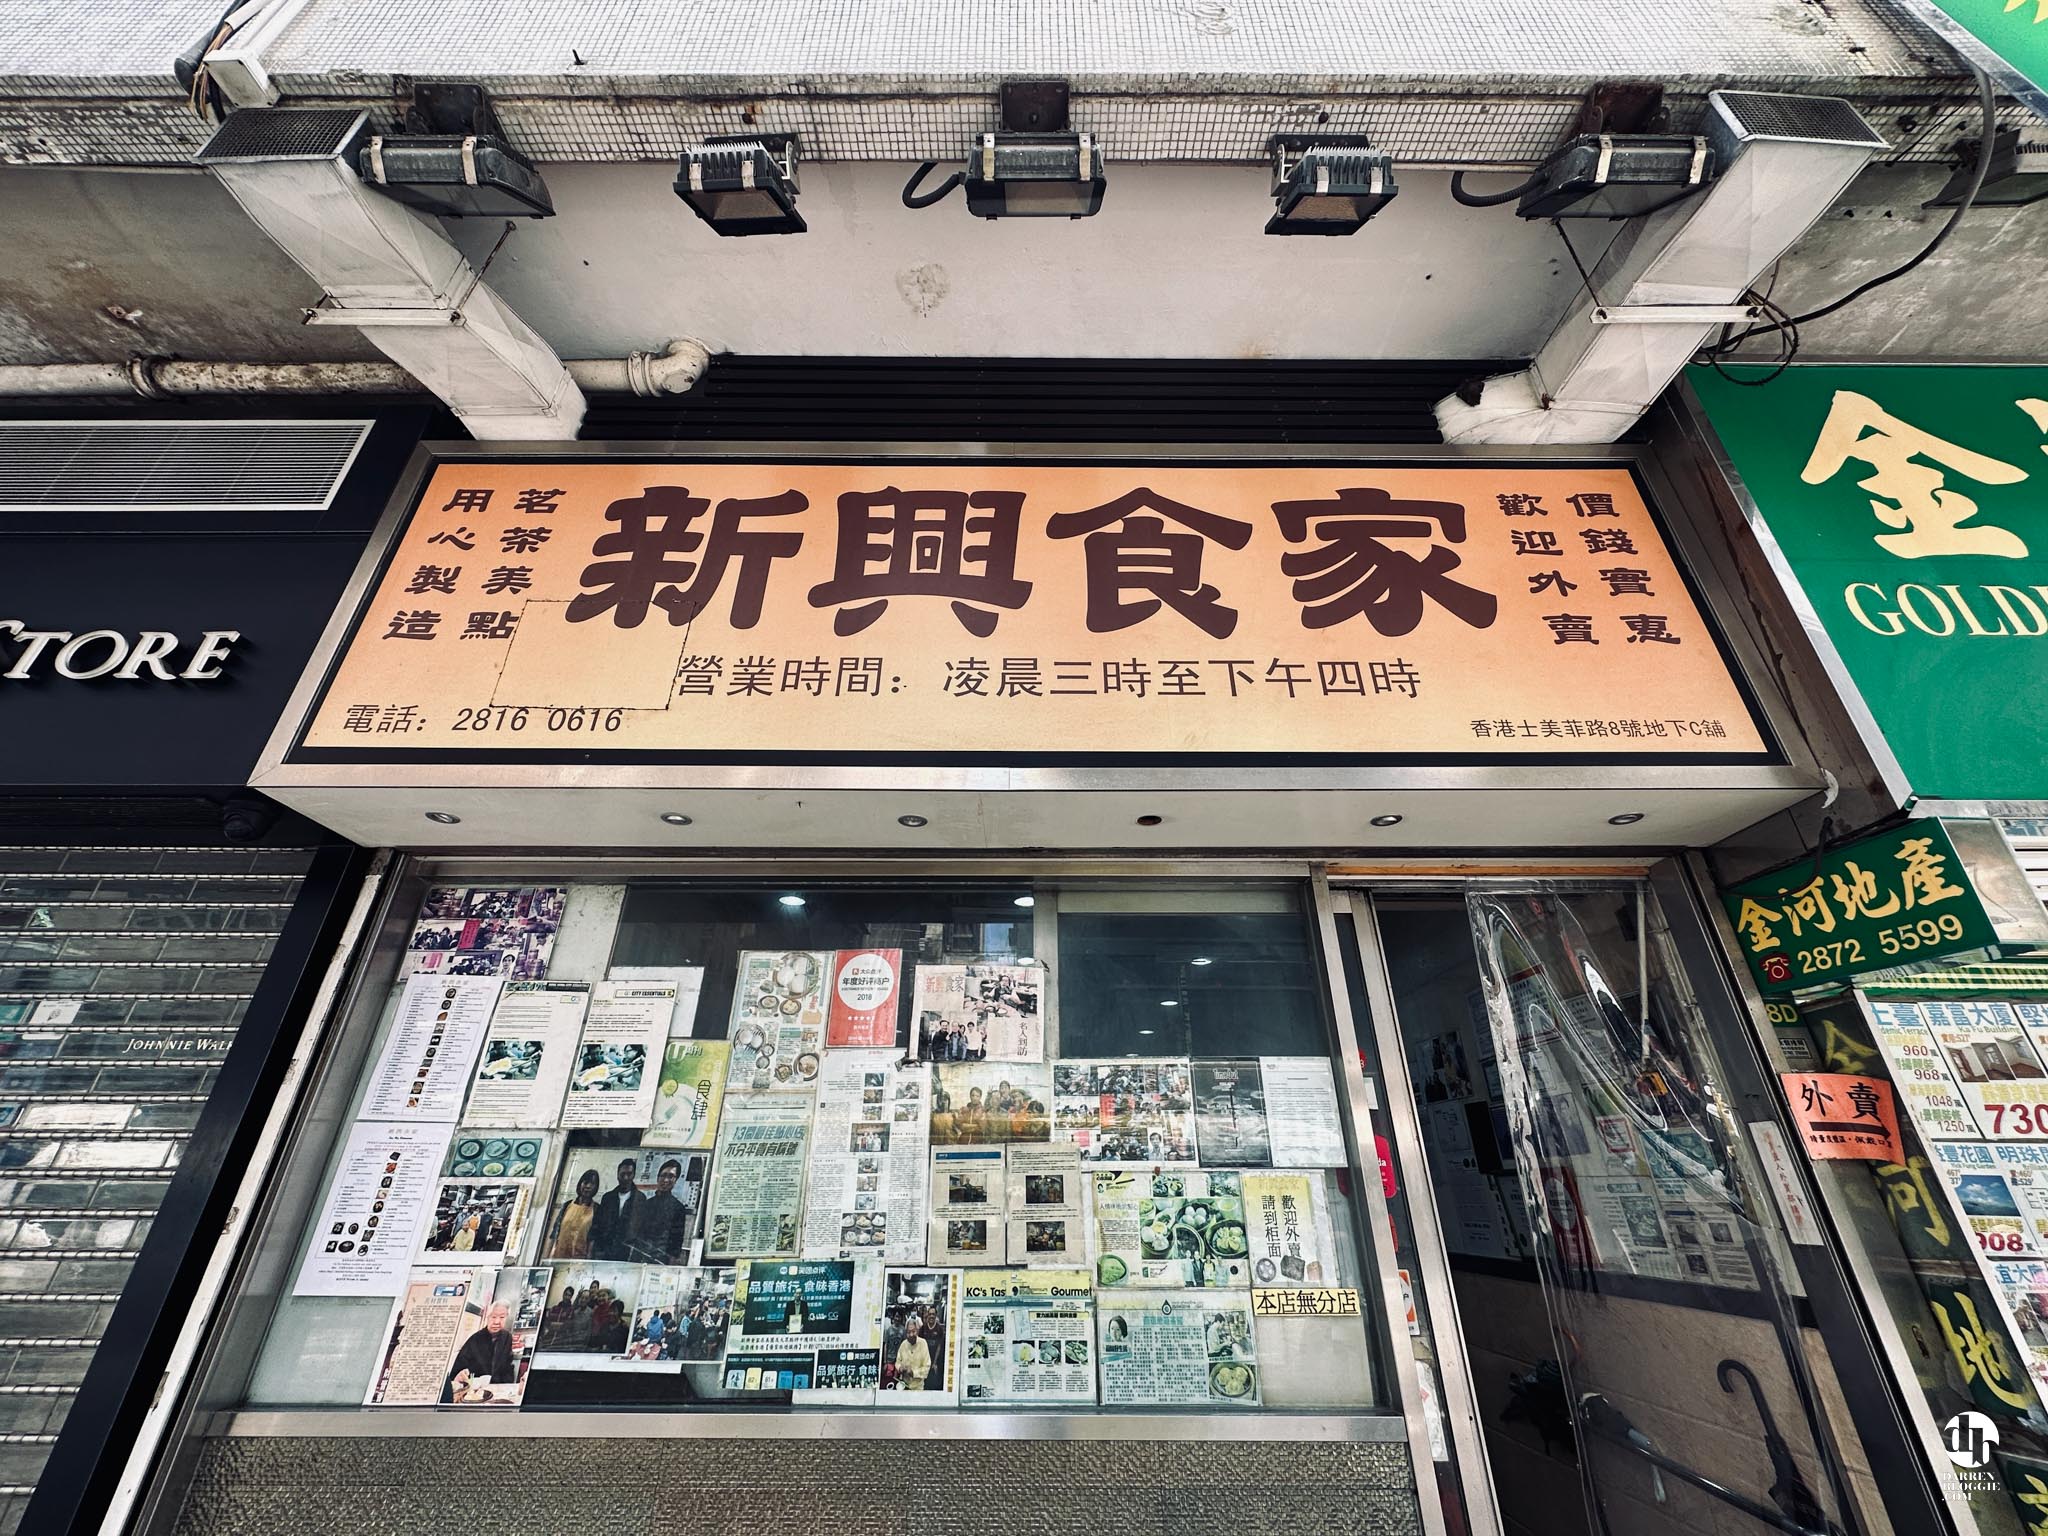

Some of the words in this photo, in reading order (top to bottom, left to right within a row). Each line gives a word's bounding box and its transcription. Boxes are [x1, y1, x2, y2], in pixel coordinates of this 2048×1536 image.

[382, 489, 495, 640] 用心製造
[459, 488, 567, 640] 茗茶美點
[565, 486, 1498, 639] 新興食家
[1496, 493, 1599, 645] 歡迎外賣
[1565, 493, 1681, 644] 價錢實惠
[1844, 582, 2048, 637] GOLD
[943, 656, 1422, 699] 凌晨三時至下午四時
[451, 707, 530, 732] 2816
[547, 708, 624, 732] 0616
[1470, 719, 1727, 738] 香港士美菲路8號地下C舖
[1737, 837, 1965, 953] 金河地產
[1797, 938, 1866, 974] 2872
[1878, 914, 1964, 955] 5599
[1923, 1002, 2017, 1027] 嘉富大廈
[1801, 1080, 1882, 1122] 外賣
[1281, 1194, 1302, 1258] 歡迎外賣
[1255, 1290, 1358, 1315] 本店無分店
